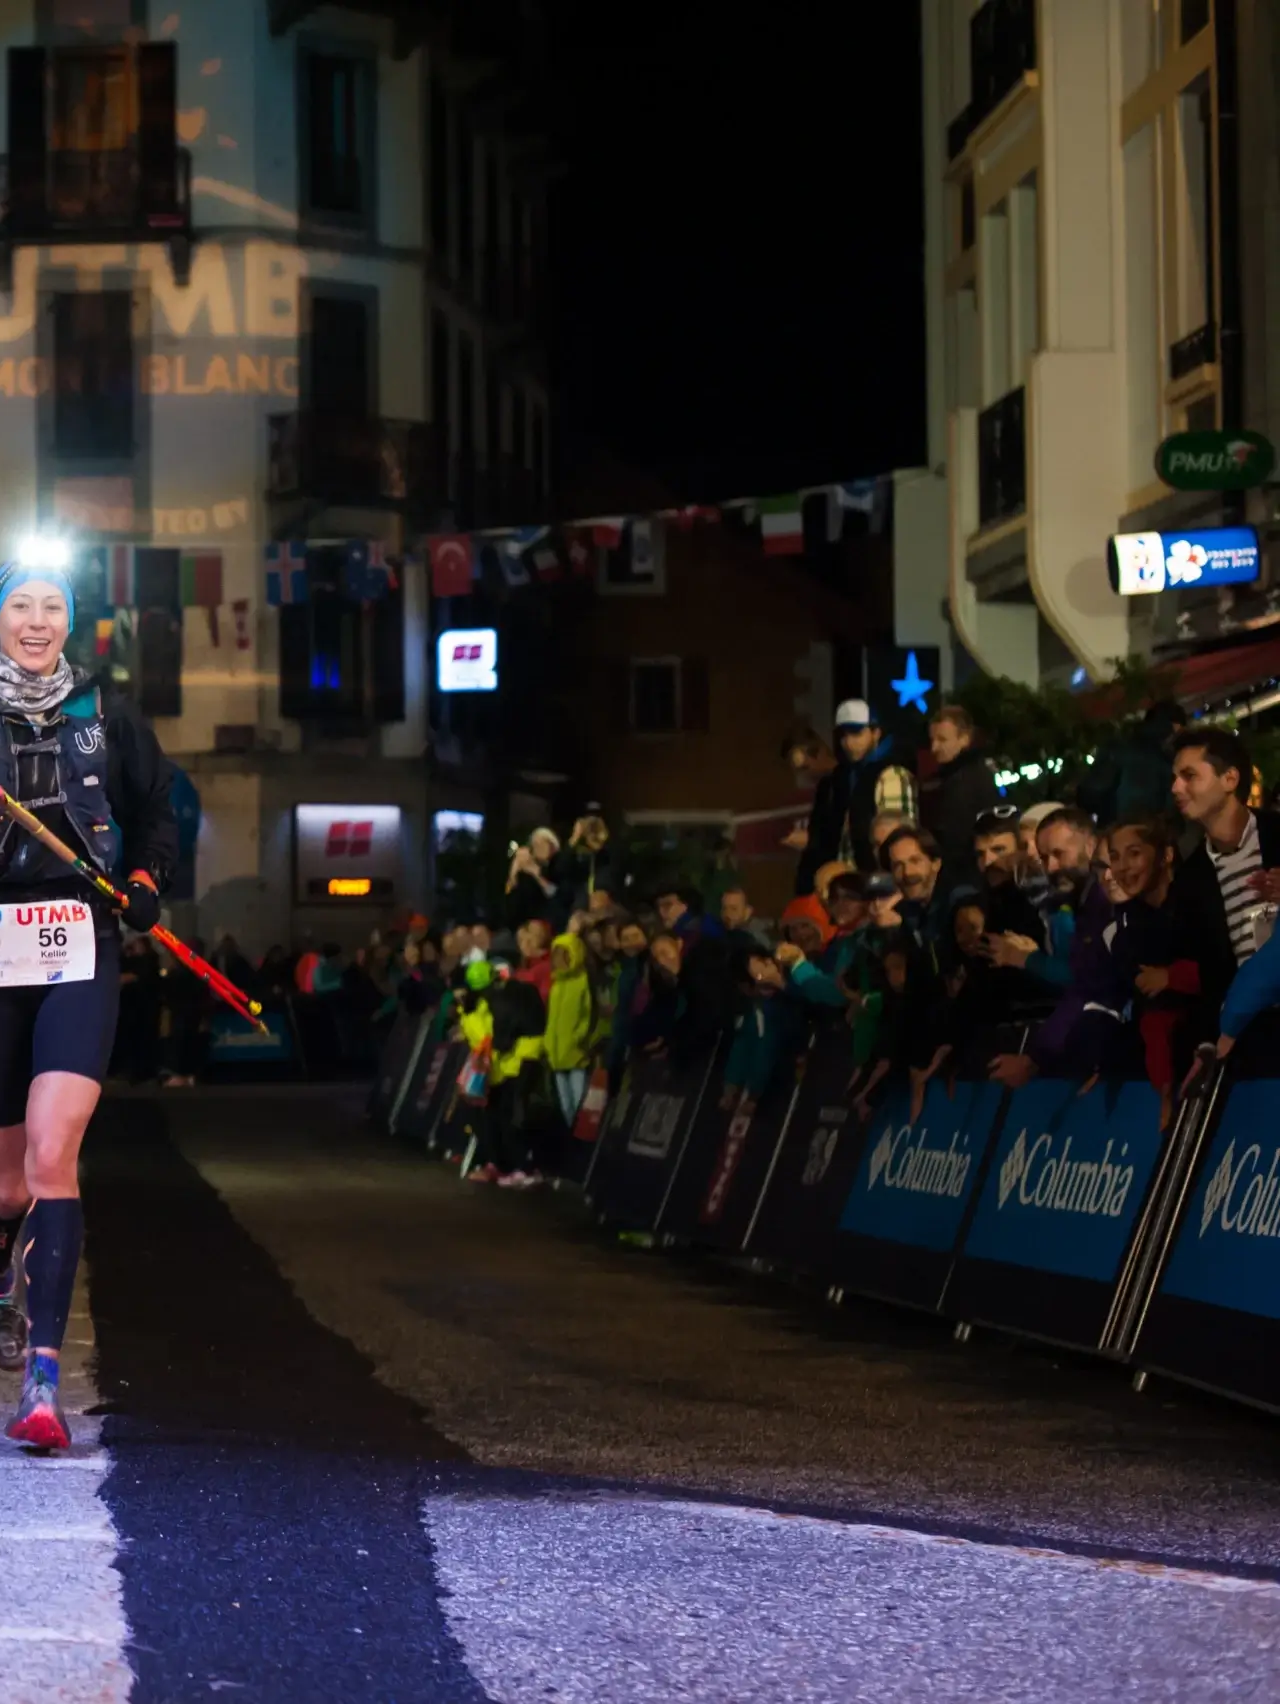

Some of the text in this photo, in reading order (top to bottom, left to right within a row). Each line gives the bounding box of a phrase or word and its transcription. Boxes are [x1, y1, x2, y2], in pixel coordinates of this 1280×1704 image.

[1169, 451, 1224, 474] PMU
[16, 904, 87, 926] UTMB
[38, 927, 68, 947] 56
[40, 949, 68, 959] Kellie
[884, 1123, 972, 1198] Columbia
[1019, 1133, 1134, 1218] Columbia
